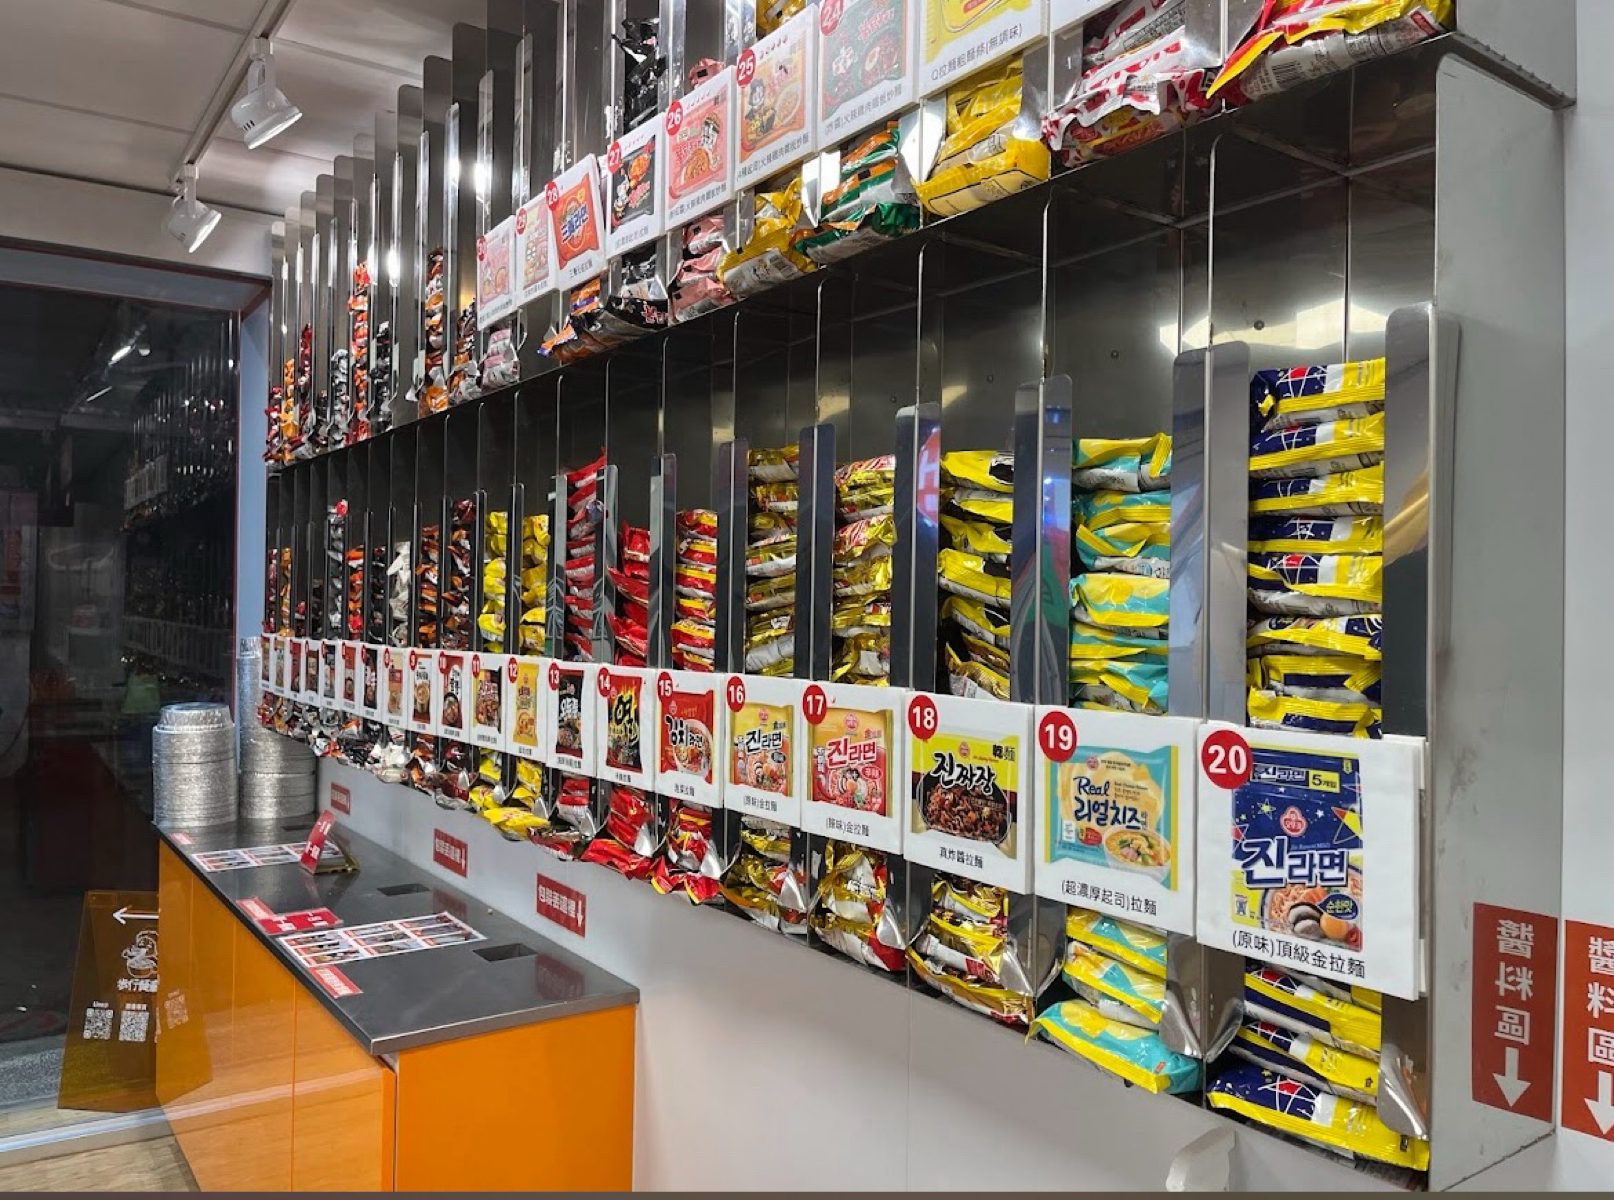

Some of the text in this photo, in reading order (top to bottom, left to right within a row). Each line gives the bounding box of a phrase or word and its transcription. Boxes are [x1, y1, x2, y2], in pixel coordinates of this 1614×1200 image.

[824, 0, 843, 26] 24
[738, 56, 754, 81] 25
[668, 108, 681, 129] 26
[608, 149, 620, 167] 27
[548, 188, 558, 205] 28
[472, 660, 479, 674] 11
[509, 663, 517, 675] 12
[549, 669, 560, 685] 13
[600, 675, 611, 691] 14
[659, 679, 672, 697] 15
[729, 685, 744, 704] 16
[806, 694, 824, 716] 17
[912, 705, 936, 731] 18
[745, 729, 783, 754] 진라면
[1045, 723, 1074, 751] 19
[827, 737, 877, 766] 진라면
[1207, 744, 1248, 776] 20
[930, 752, 996, 795] 진짜장
[1073, 775, 1110, 797] Real
[1074, 796, 1141, 830] 리얼치즈
[1241, 836, 1347, 887] 진라면
[1061, 880, 1158, 917] (超濃厚起司)拉麵
[1325, 899, 1353, 916] 순한맛
[1232, 929, 1366, 980] (原味)頂級金拉麵
